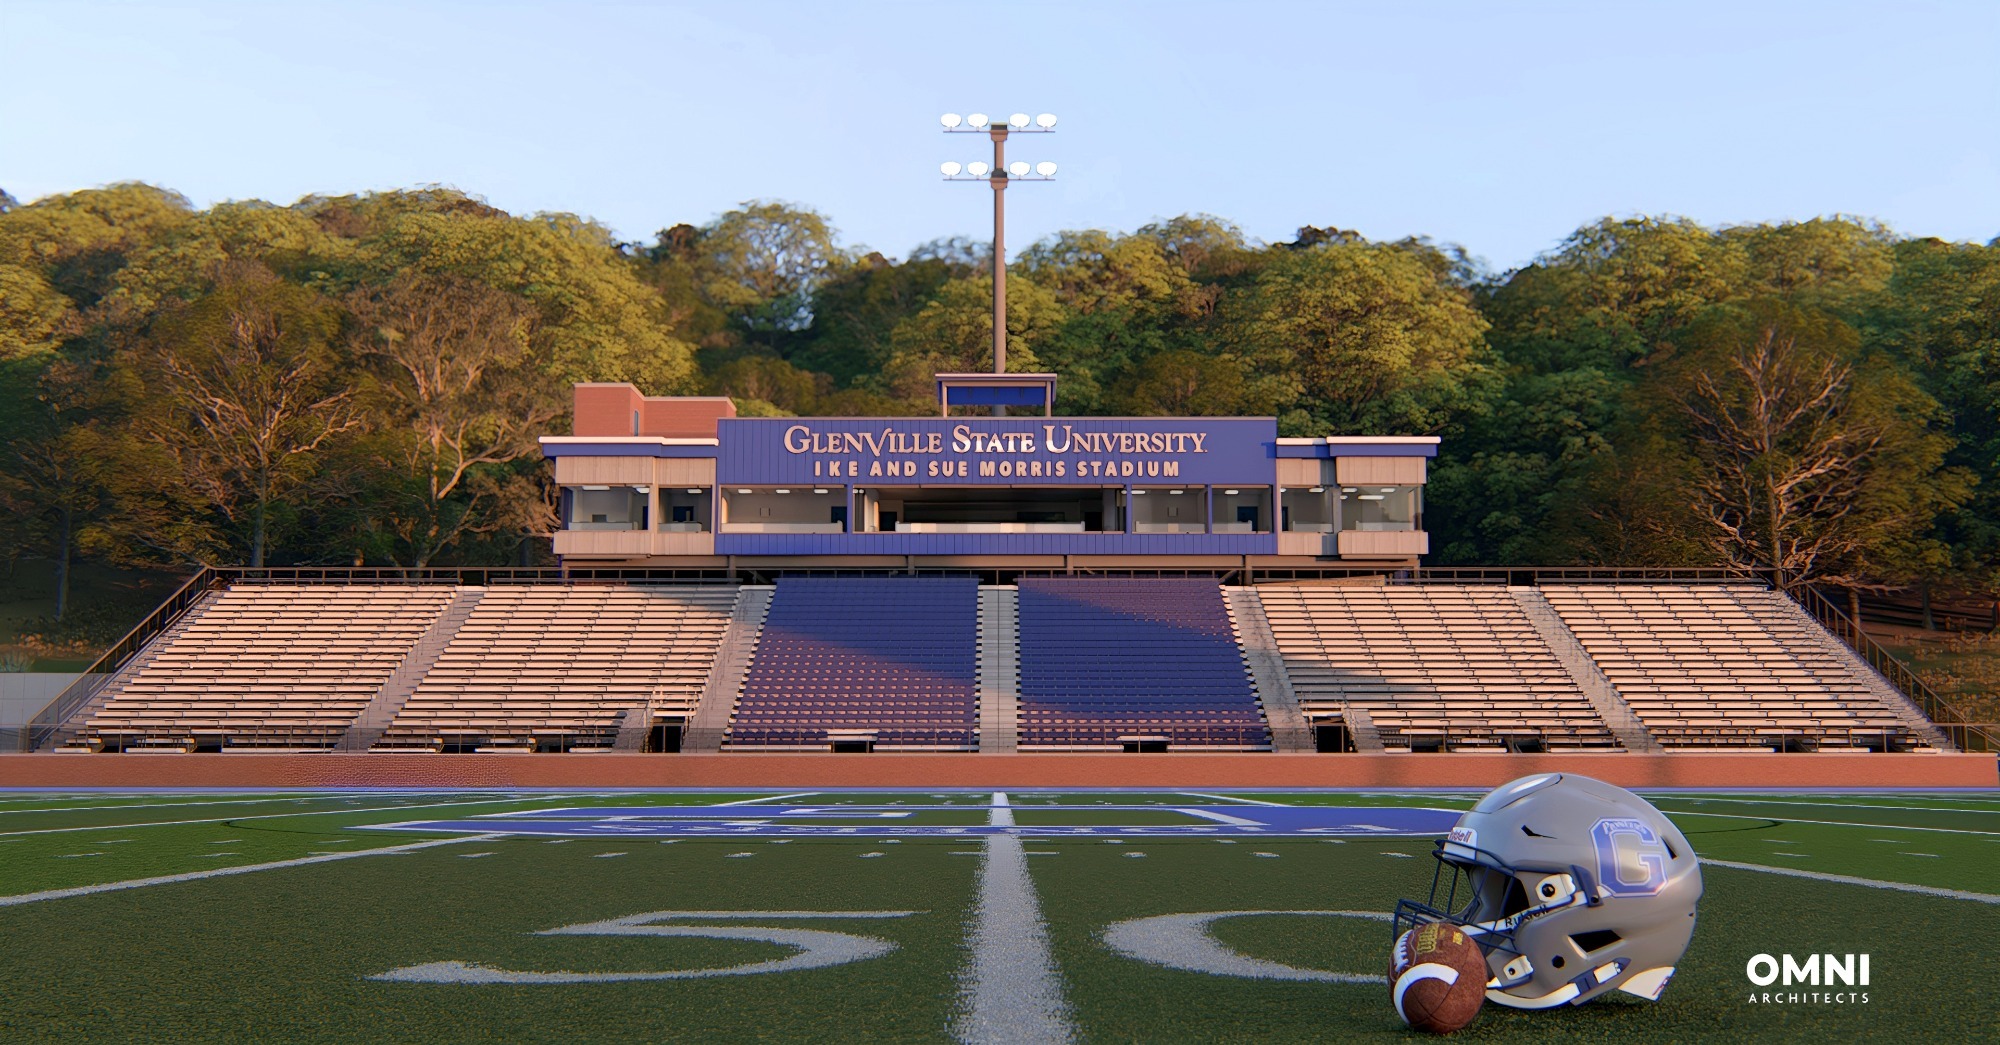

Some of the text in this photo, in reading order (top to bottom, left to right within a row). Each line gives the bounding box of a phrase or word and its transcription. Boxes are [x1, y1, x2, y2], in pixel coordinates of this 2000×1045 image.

[784, 425, 943, 457] GLENVILLE
[952, 425, 1036, 453] STATE
[815, 461, 1180, 477] IKE AND SUE MORRIS STADIUM
[1588, 816, 1668, 898] G
